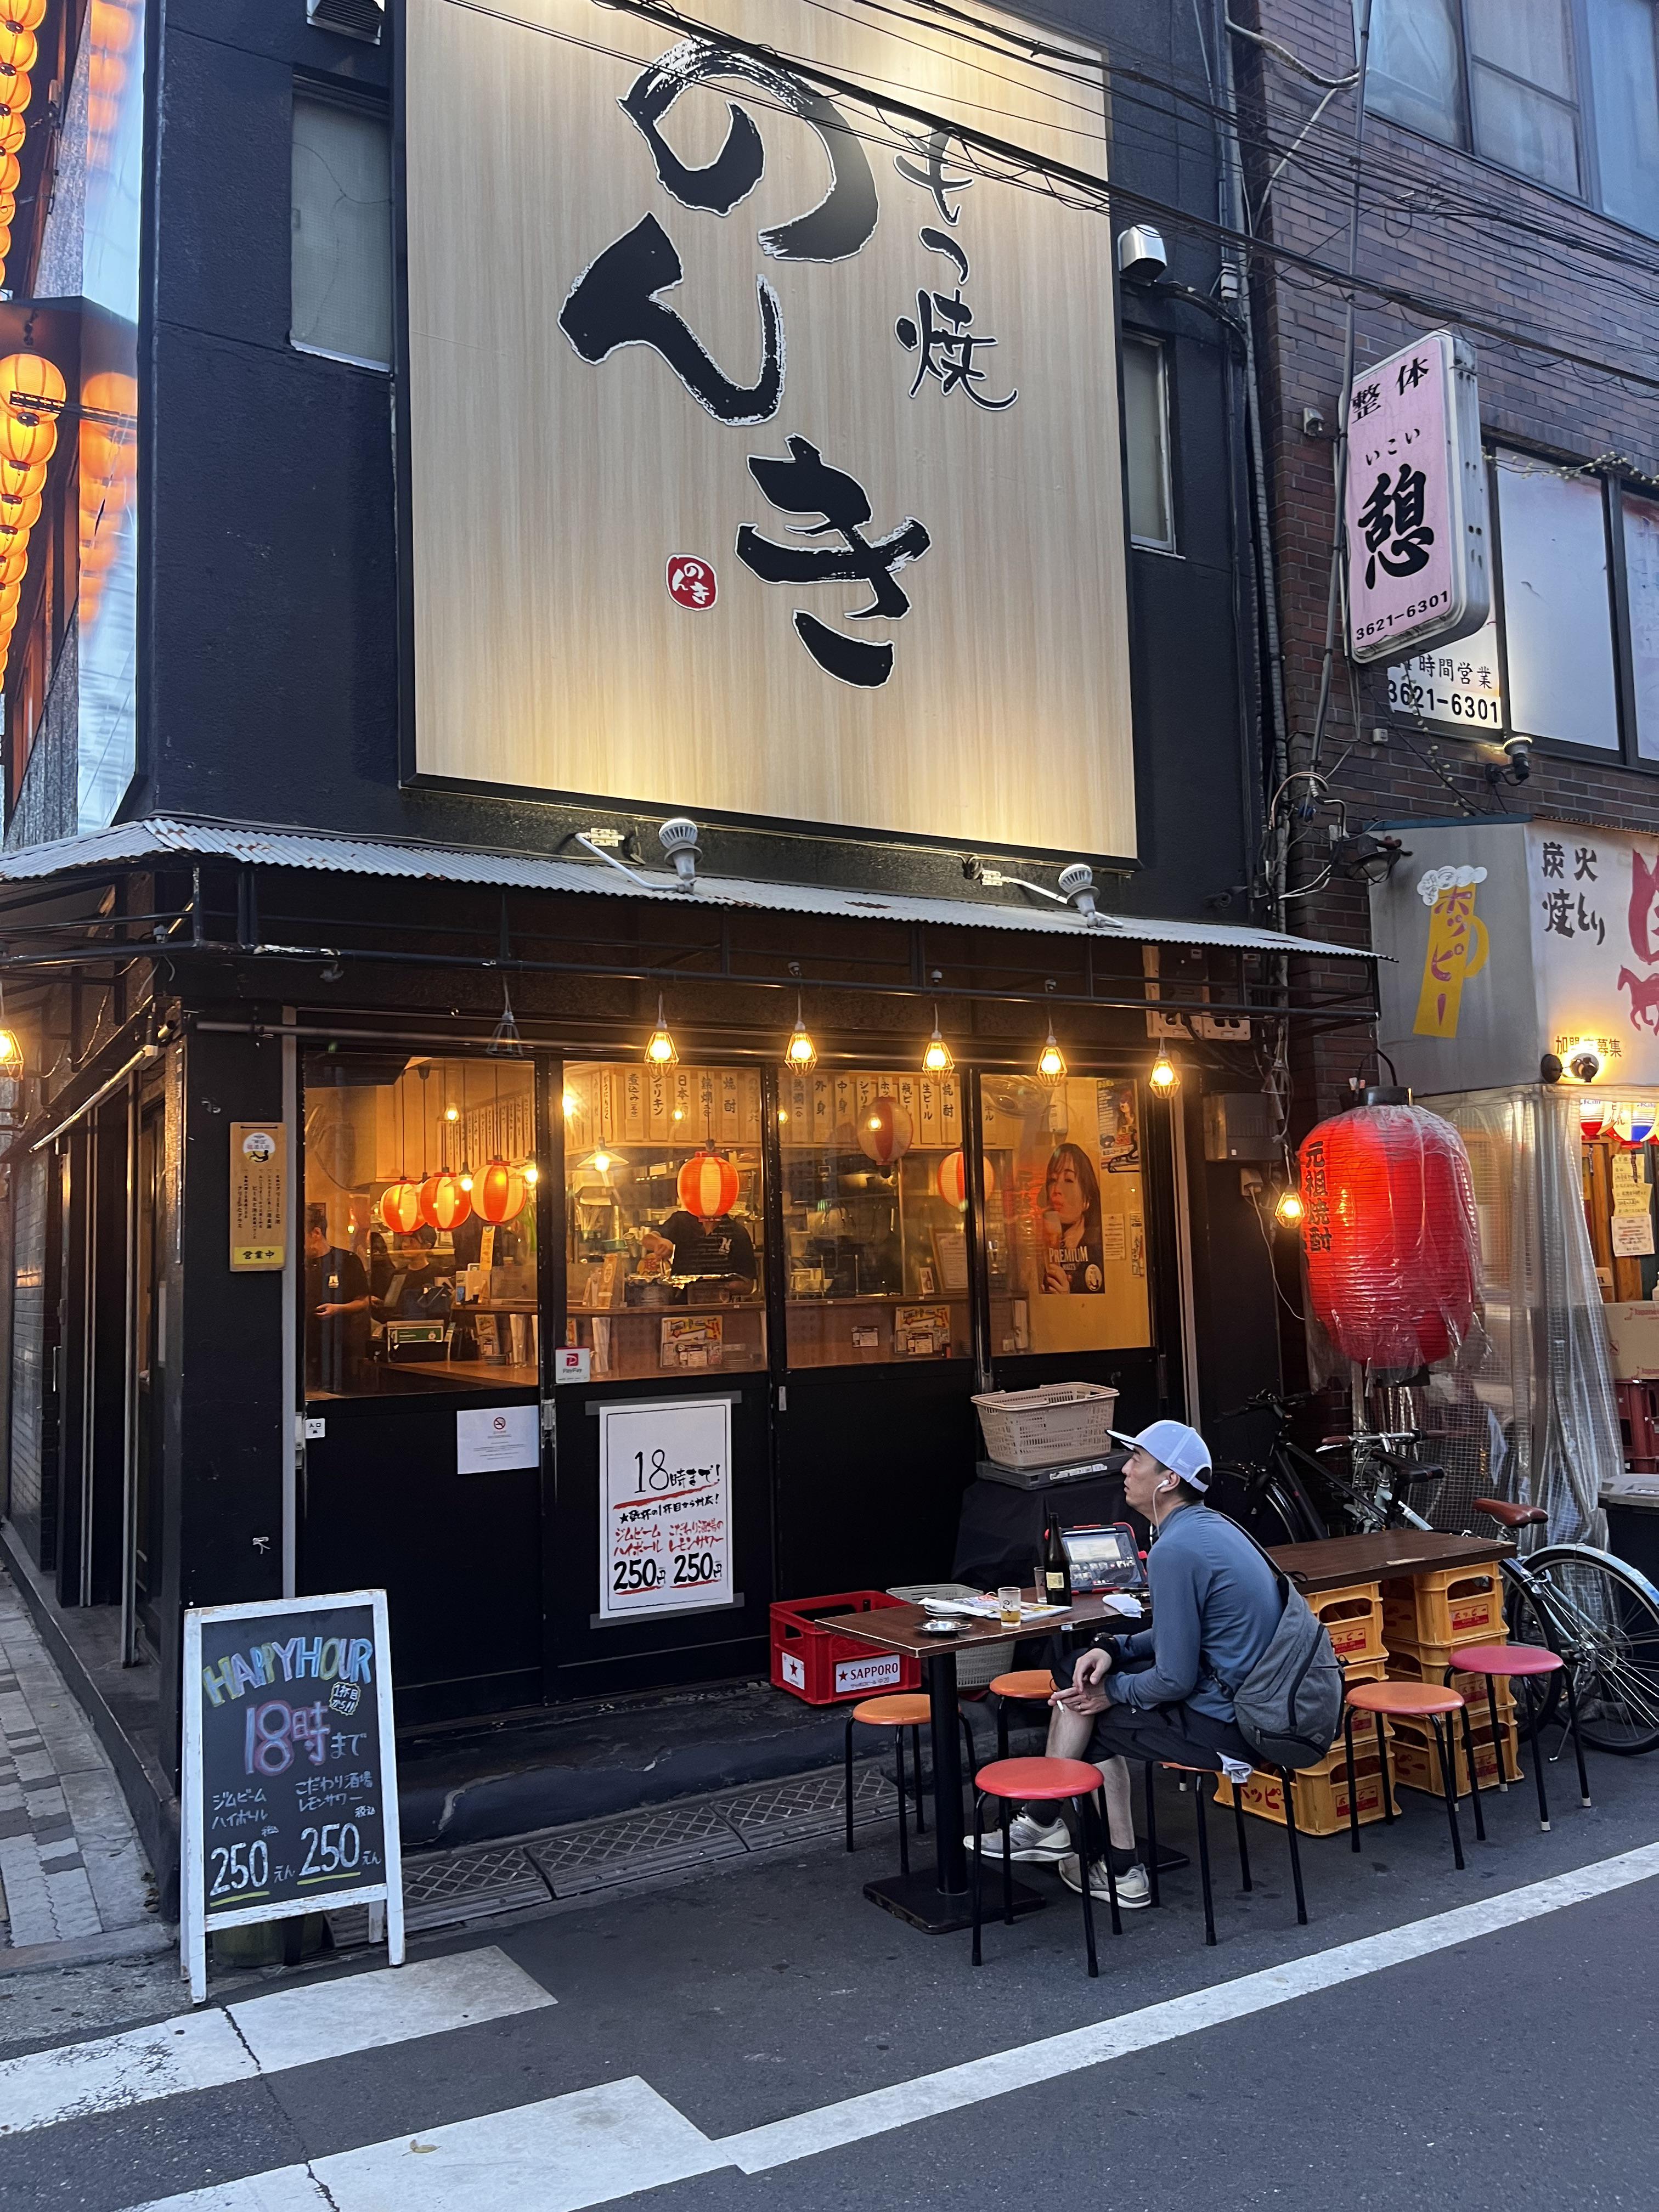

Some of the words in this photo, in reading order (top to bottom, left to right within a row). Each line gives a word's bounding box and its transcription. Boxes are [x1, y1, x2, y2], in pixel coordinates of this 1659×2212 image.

[893, 125, 1018, 410] もつ焼
[558, 36, 932, 689] のんき
[1350, 357, 1429, 424] 整体
[1364, 427, 1421, 466] いこい
[1357, 462, 1435, 590] 憩
[1356, 590, 1449, 641] 3621-6301
[1406, 654, 1493, 689] 時間営業
[1388, 680, 1498, 723] 3621-6301
[1541, 841, 1599, 882] 炭火
[1542, 888, 1605, 946] 焼とり
[1431, 885, 1473, 1026] ホッピー
[1556, 1035, 1622, 1058] 加盟募集
[1305, 1141, 1333, 1253] 元祖焼酎
[242, 1250, 275, 1260] 営業中
[1048, 1246, 1089, 1262] PREMIUM
[850, 1662, 898, 1681] SAPPORO
[212, 1788, 268, 1811] ジムビーム
[298, 1792, 364, 1812] レモンサワー
